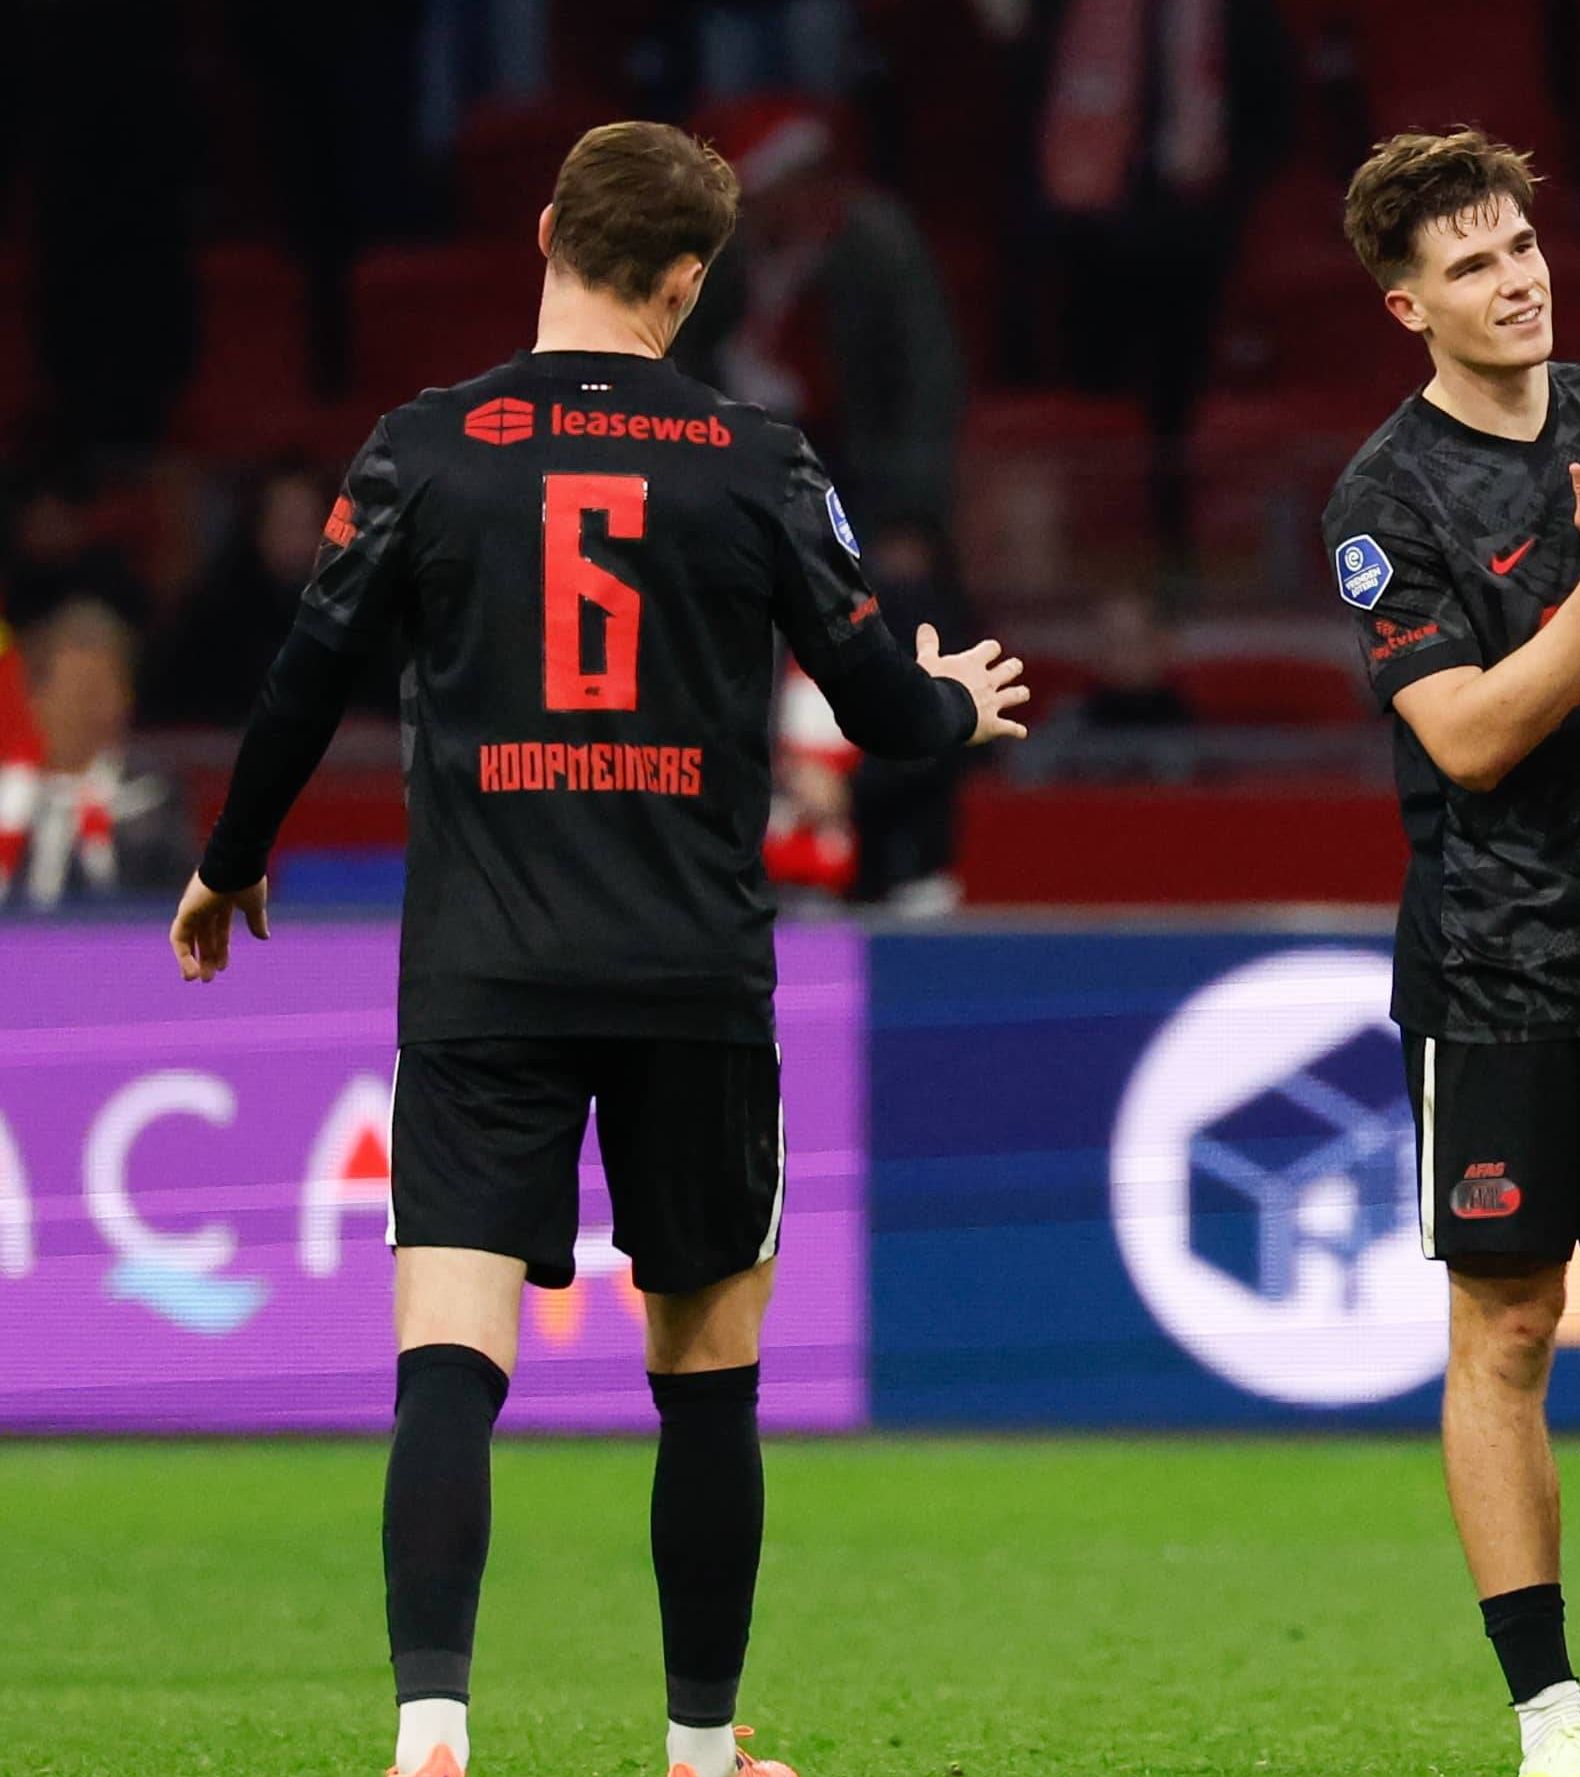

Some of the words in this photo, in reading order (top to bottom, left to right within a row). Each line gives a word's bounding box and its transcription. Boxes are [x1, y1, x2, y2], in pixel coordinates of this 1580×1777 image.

[552, 404, 731, 448] leaseweb
[544, 474, 648, 711] 6
[480, 742, 702, 795] KOOPMEINERS
